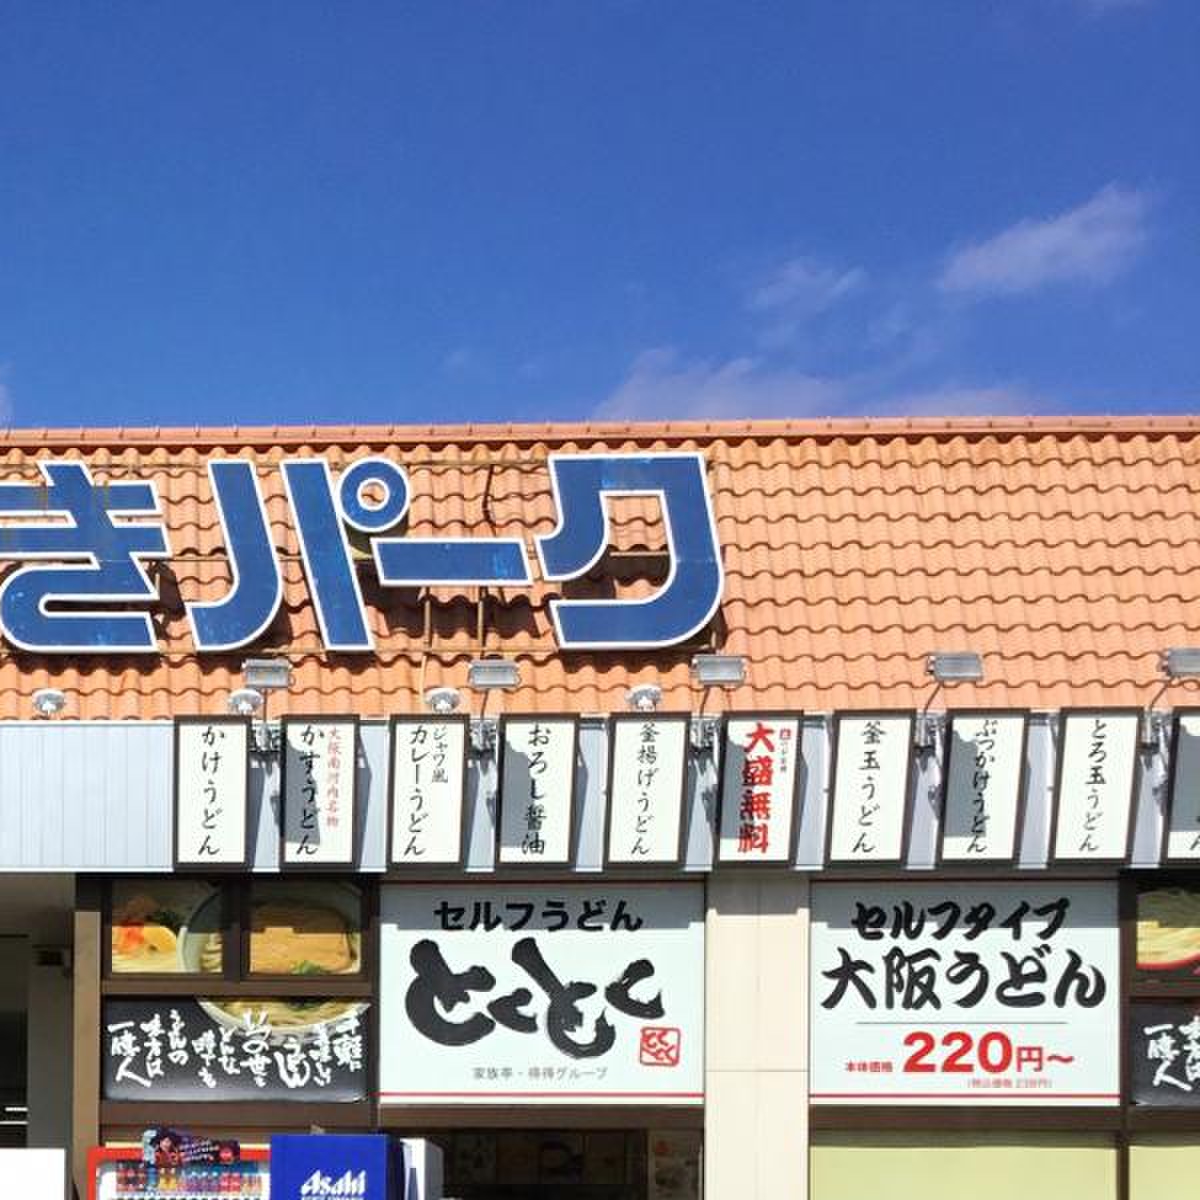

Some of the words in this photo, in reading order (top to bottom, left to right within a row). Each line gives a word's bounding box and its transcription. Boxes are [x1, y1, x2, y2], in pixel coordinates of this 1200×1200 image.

[198, 725, 225, 856] かけうどん
[296, 725, 325, 856] かすうどん
[403, 725, 430, 857] カレーうどん
[631, 722, 660, 855] 釜揚げうどん
[738, 721, 775, 854] 大盛無料
[851, 720, 886, 853] 釜玉うどん
[1078, 718, 1108, 852] とろ玉うどん
[434, 899, 643, 933] セルフうどん
[821, 944, 1106, 1010] 大阪うどん
[852, 898, 1070, 940] セルフタイプ
[404, 936, 665, 1060] とくとく
[300, 1169, 367, 1195] Asahi
